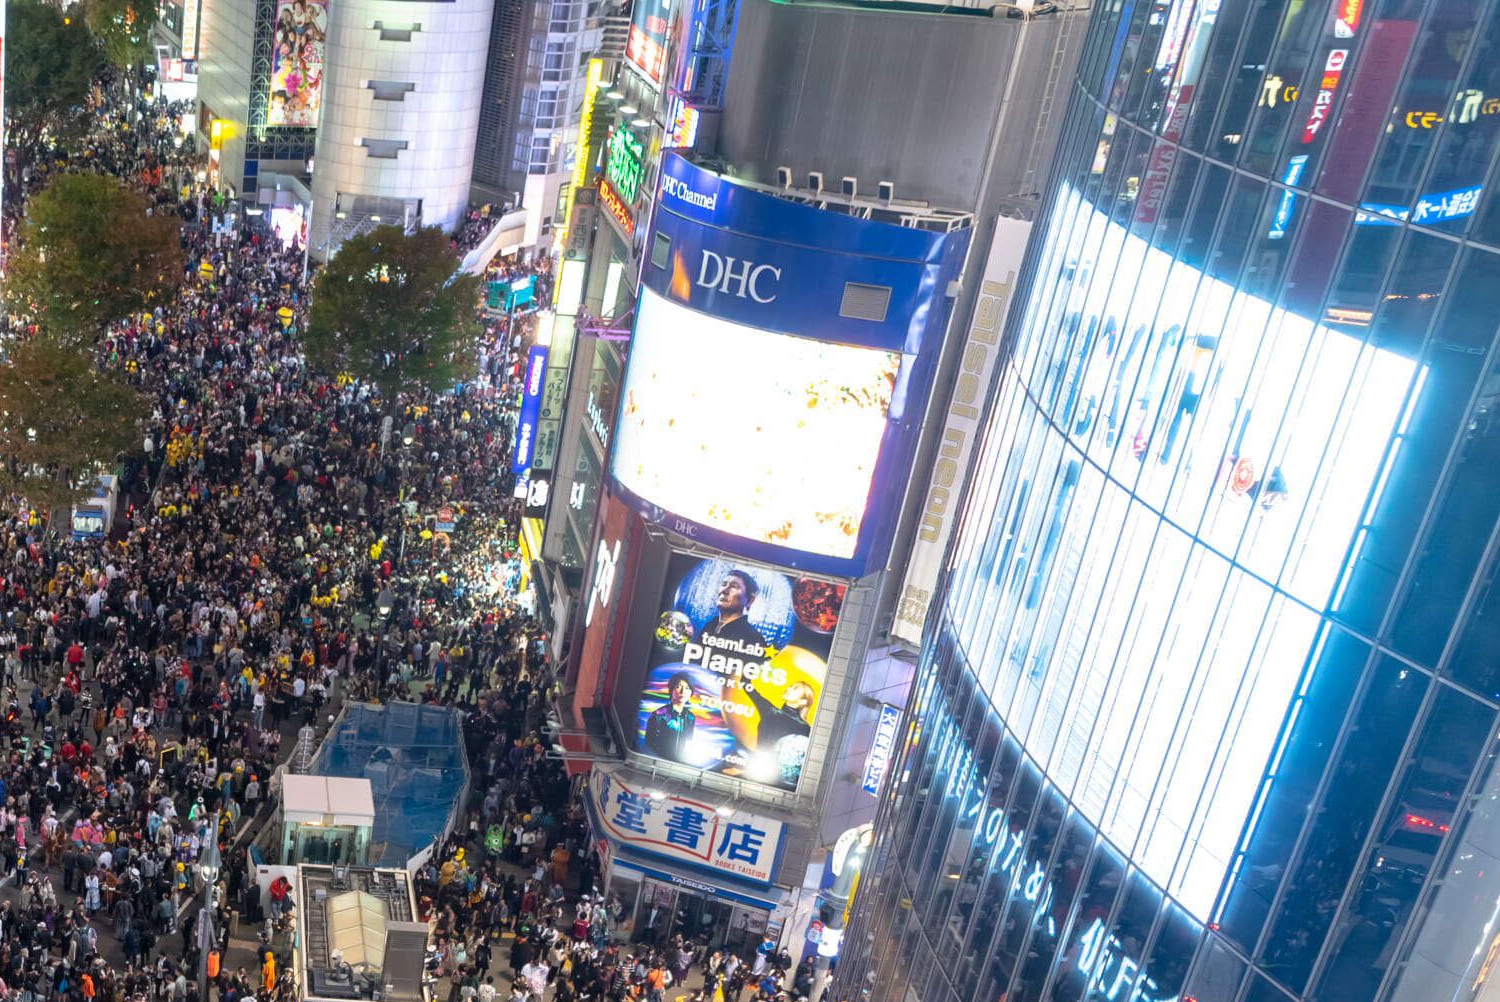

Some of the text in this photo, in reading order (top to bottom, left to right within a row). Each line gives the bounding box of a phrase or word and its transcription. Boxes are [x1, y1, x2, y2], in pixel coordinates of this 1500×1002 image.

[662, 173, 717, 211] DHC Channel
[696, 249, 782, 303] DHC
[919, 270, 1016, 543] Taisei neon
[675, 519, 698, 537] DHC
[701, 632, 765, 657] teamLab
[682, 642, 787, 686] Planets
[699, 694, 754, 717] TOYOSU
[715, 859, 767, 879] BOOKS TAISEIDO
[670, 875, 716, 894] TAISEIDO
